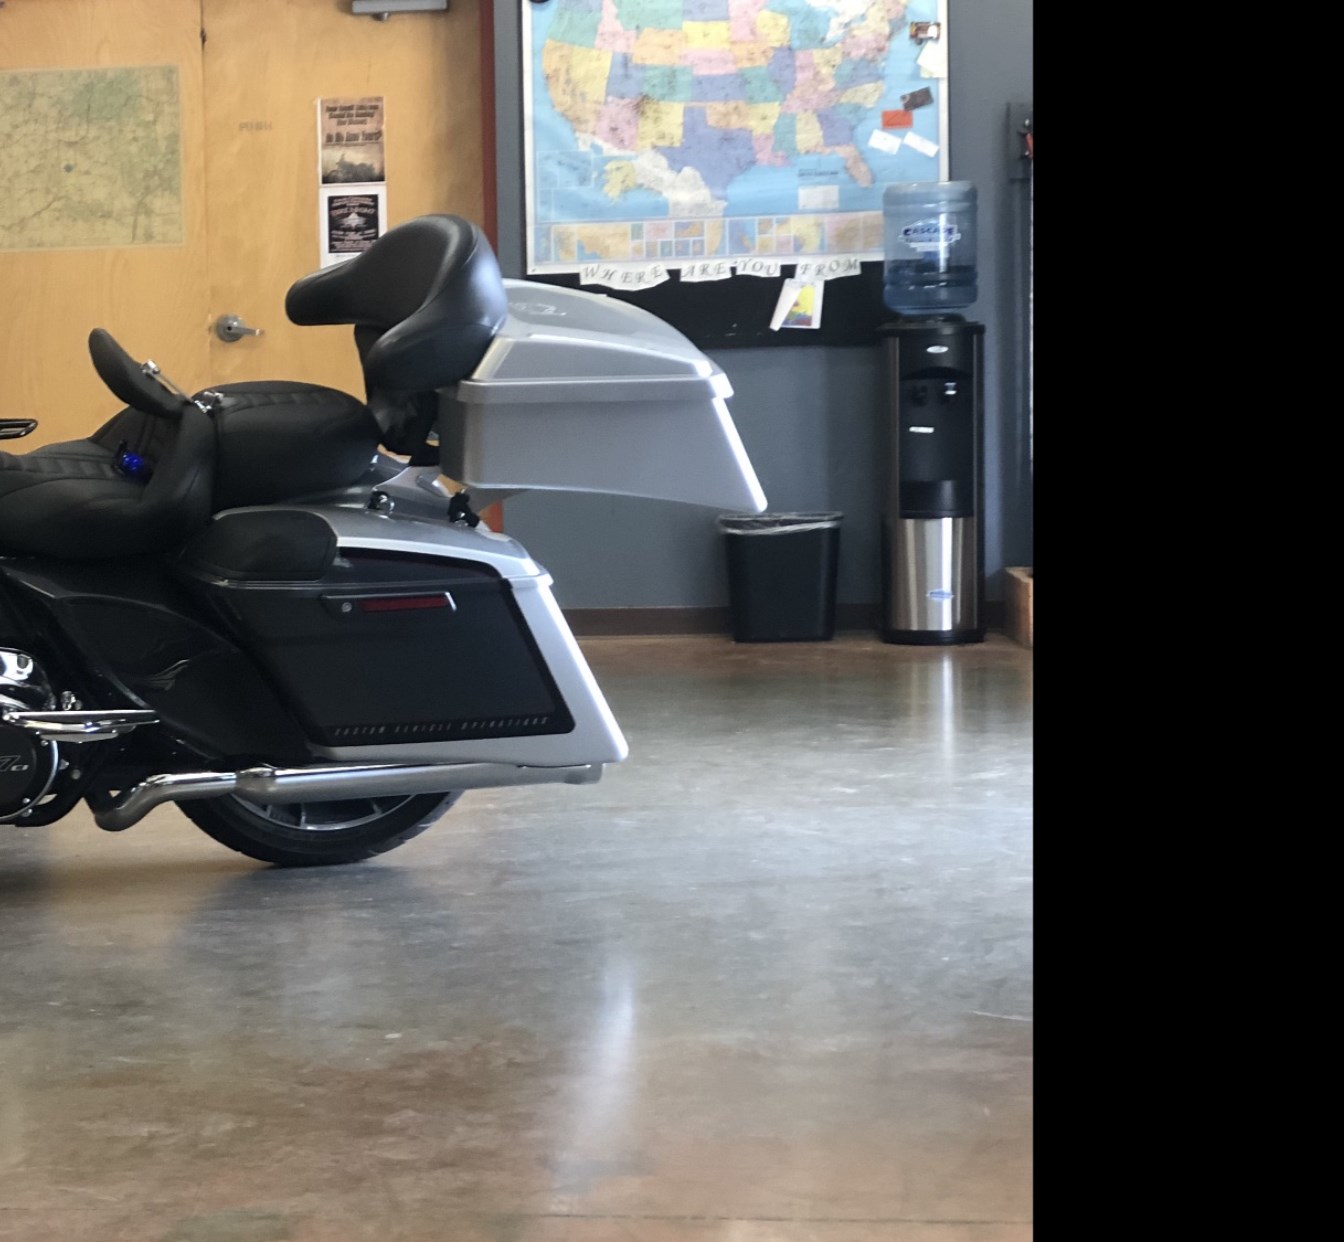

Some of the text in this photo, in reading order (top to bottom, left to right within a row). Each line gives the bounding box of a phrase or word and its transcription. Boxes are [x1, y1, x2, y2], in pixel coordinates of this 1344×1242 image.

[903, 226, 955, 236] CASCAE
[584, 259, 858, 283] WHERE ARE YOU FROM
